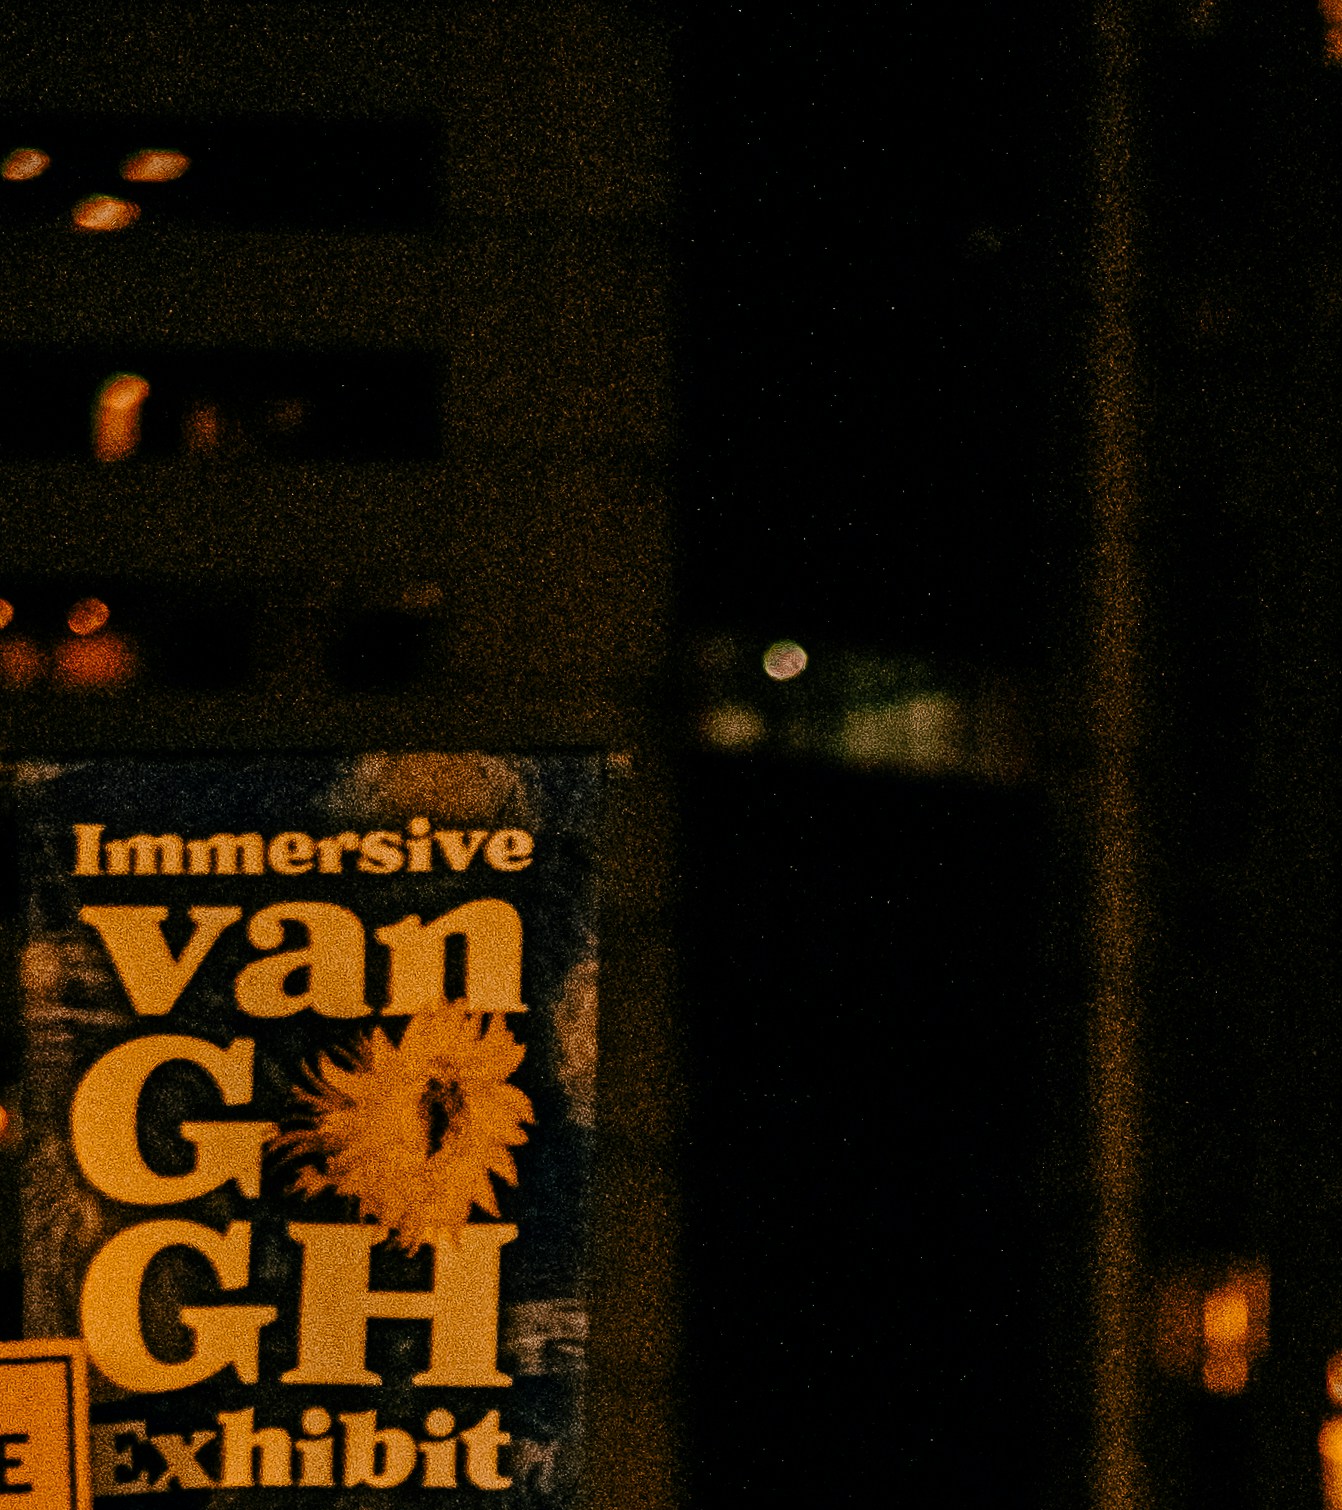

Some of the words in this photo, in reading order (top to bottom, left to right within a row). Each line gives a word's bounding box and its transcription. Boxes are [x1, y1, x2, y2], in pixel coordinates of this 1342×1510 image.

[72, 817, 534, 877] Immersive
[78, 897, 529, 1020] van
[80, 1219, 519, 1394] GH
[92, 1406, 513, 1497] Exhibit
